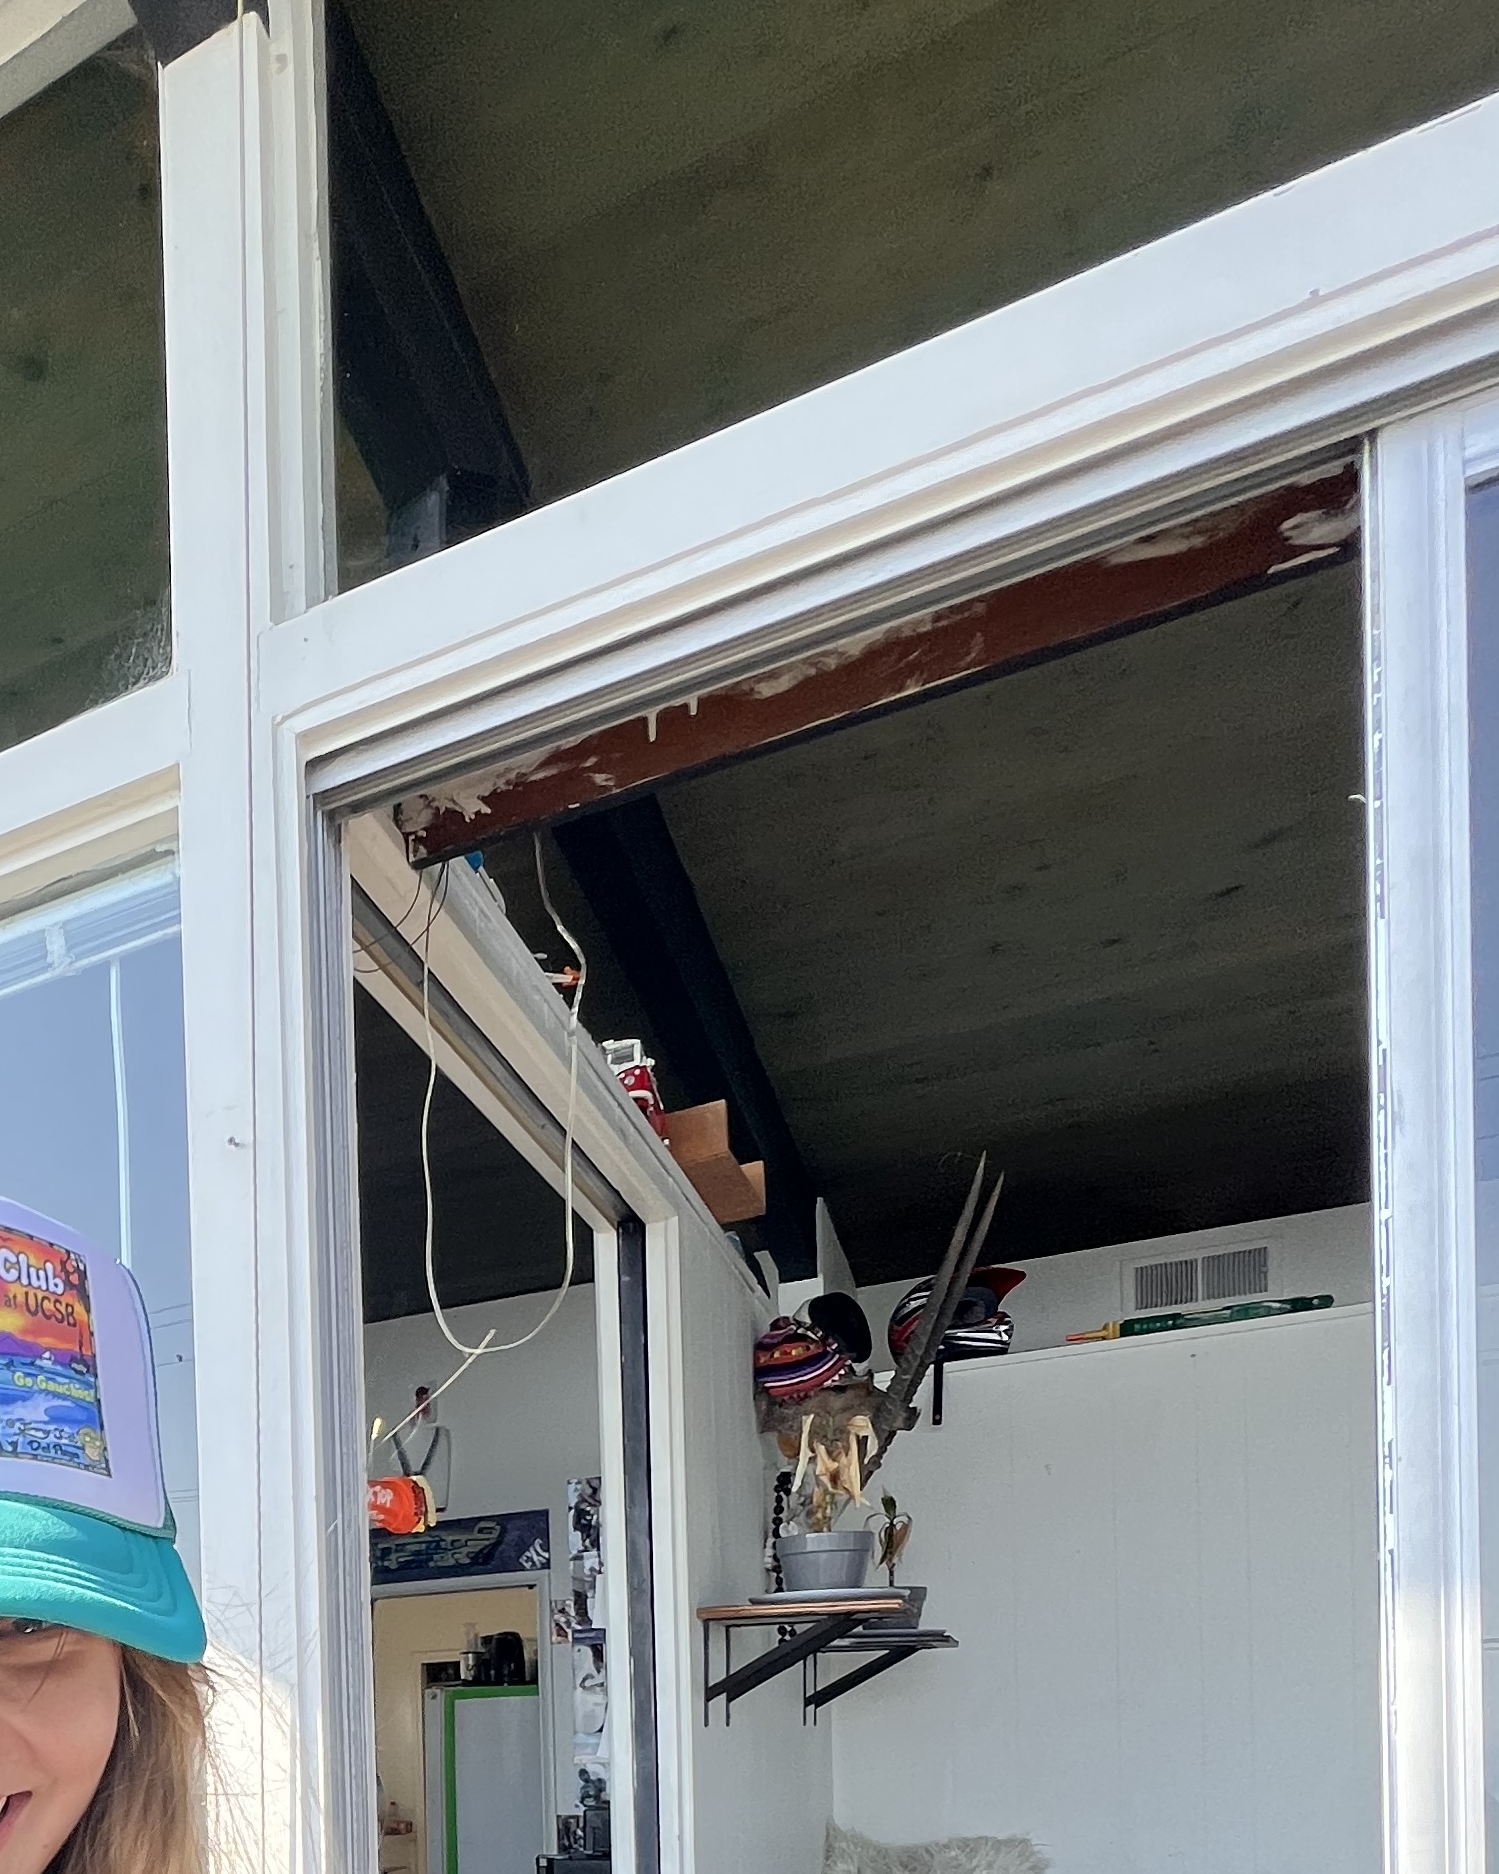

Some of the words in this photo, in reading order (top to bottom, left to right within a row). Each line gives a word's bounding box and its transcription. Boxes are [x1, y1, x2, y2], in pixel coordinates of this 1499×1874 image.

[4, 1292, 18, 1309] at
[24, 1290, 78, 1328] UCSB
[13, 1371, 34, 1388] Go
